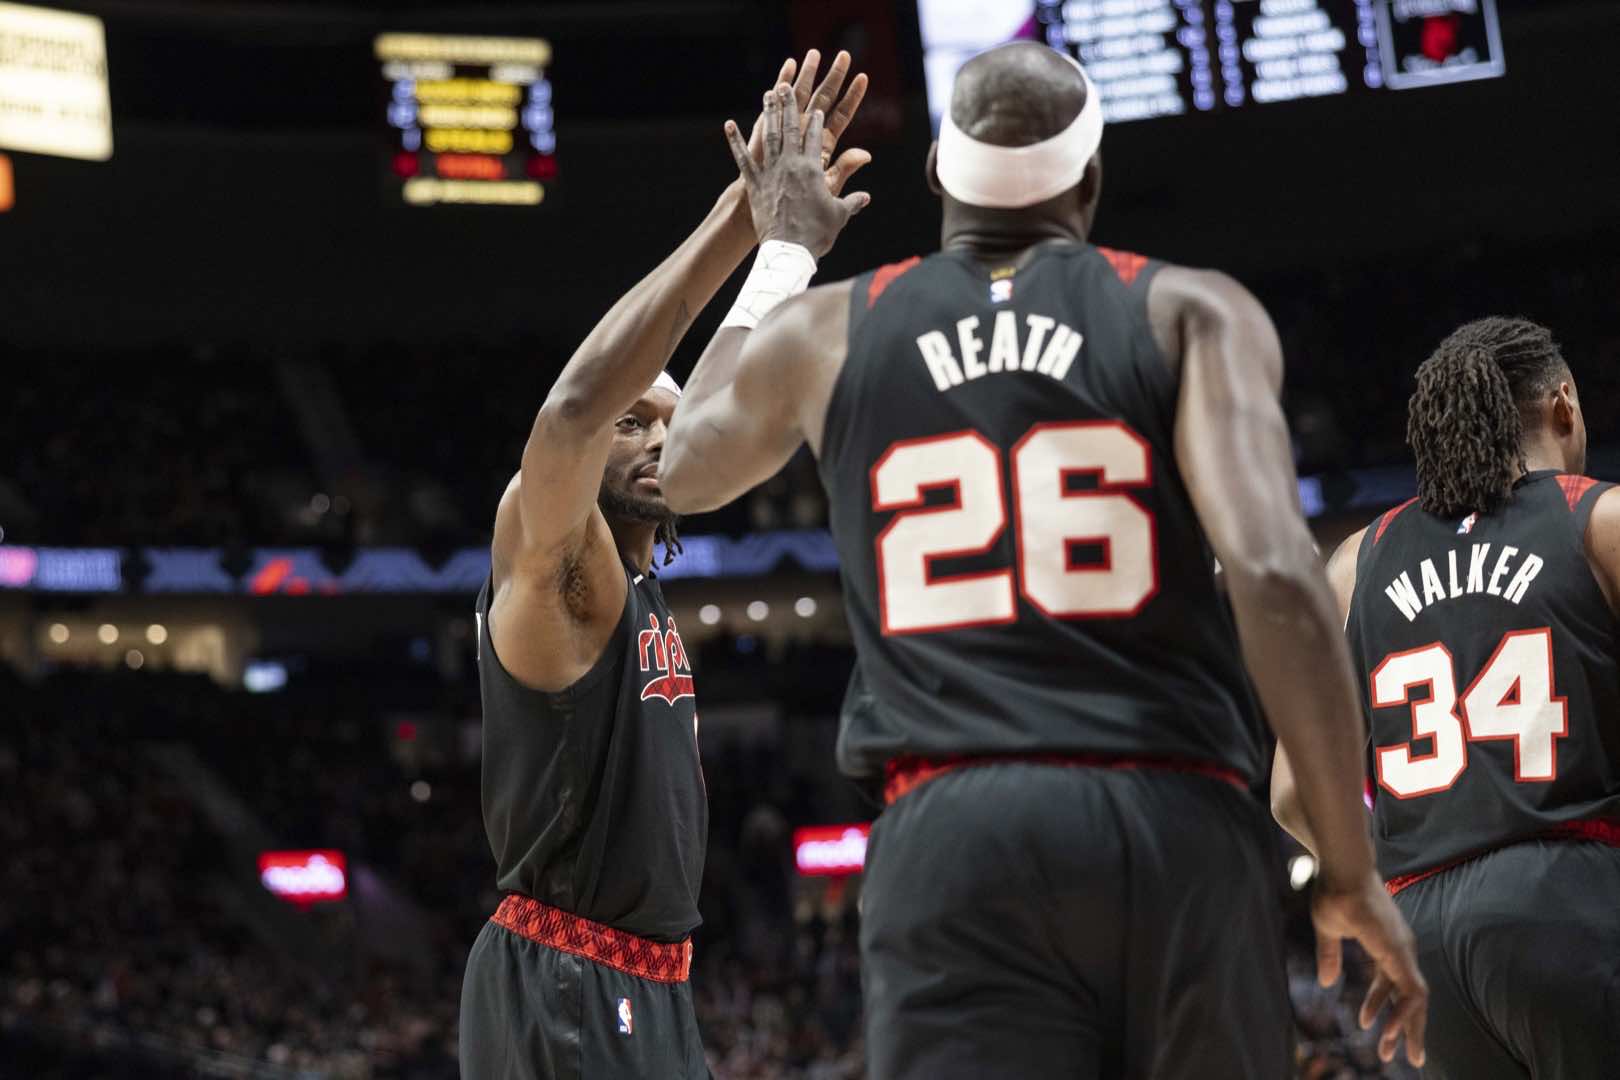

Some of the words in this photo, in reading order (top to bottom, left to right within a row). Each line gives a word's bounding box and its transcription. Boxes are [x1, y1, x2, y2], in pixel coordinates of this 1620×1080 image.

[916, 311, 1083, 392] REATH
[869, 419, 1159, 637] 26
[1385, 543, 1544, 622] WALKER
[1370, 627, 1568, 799] 34
